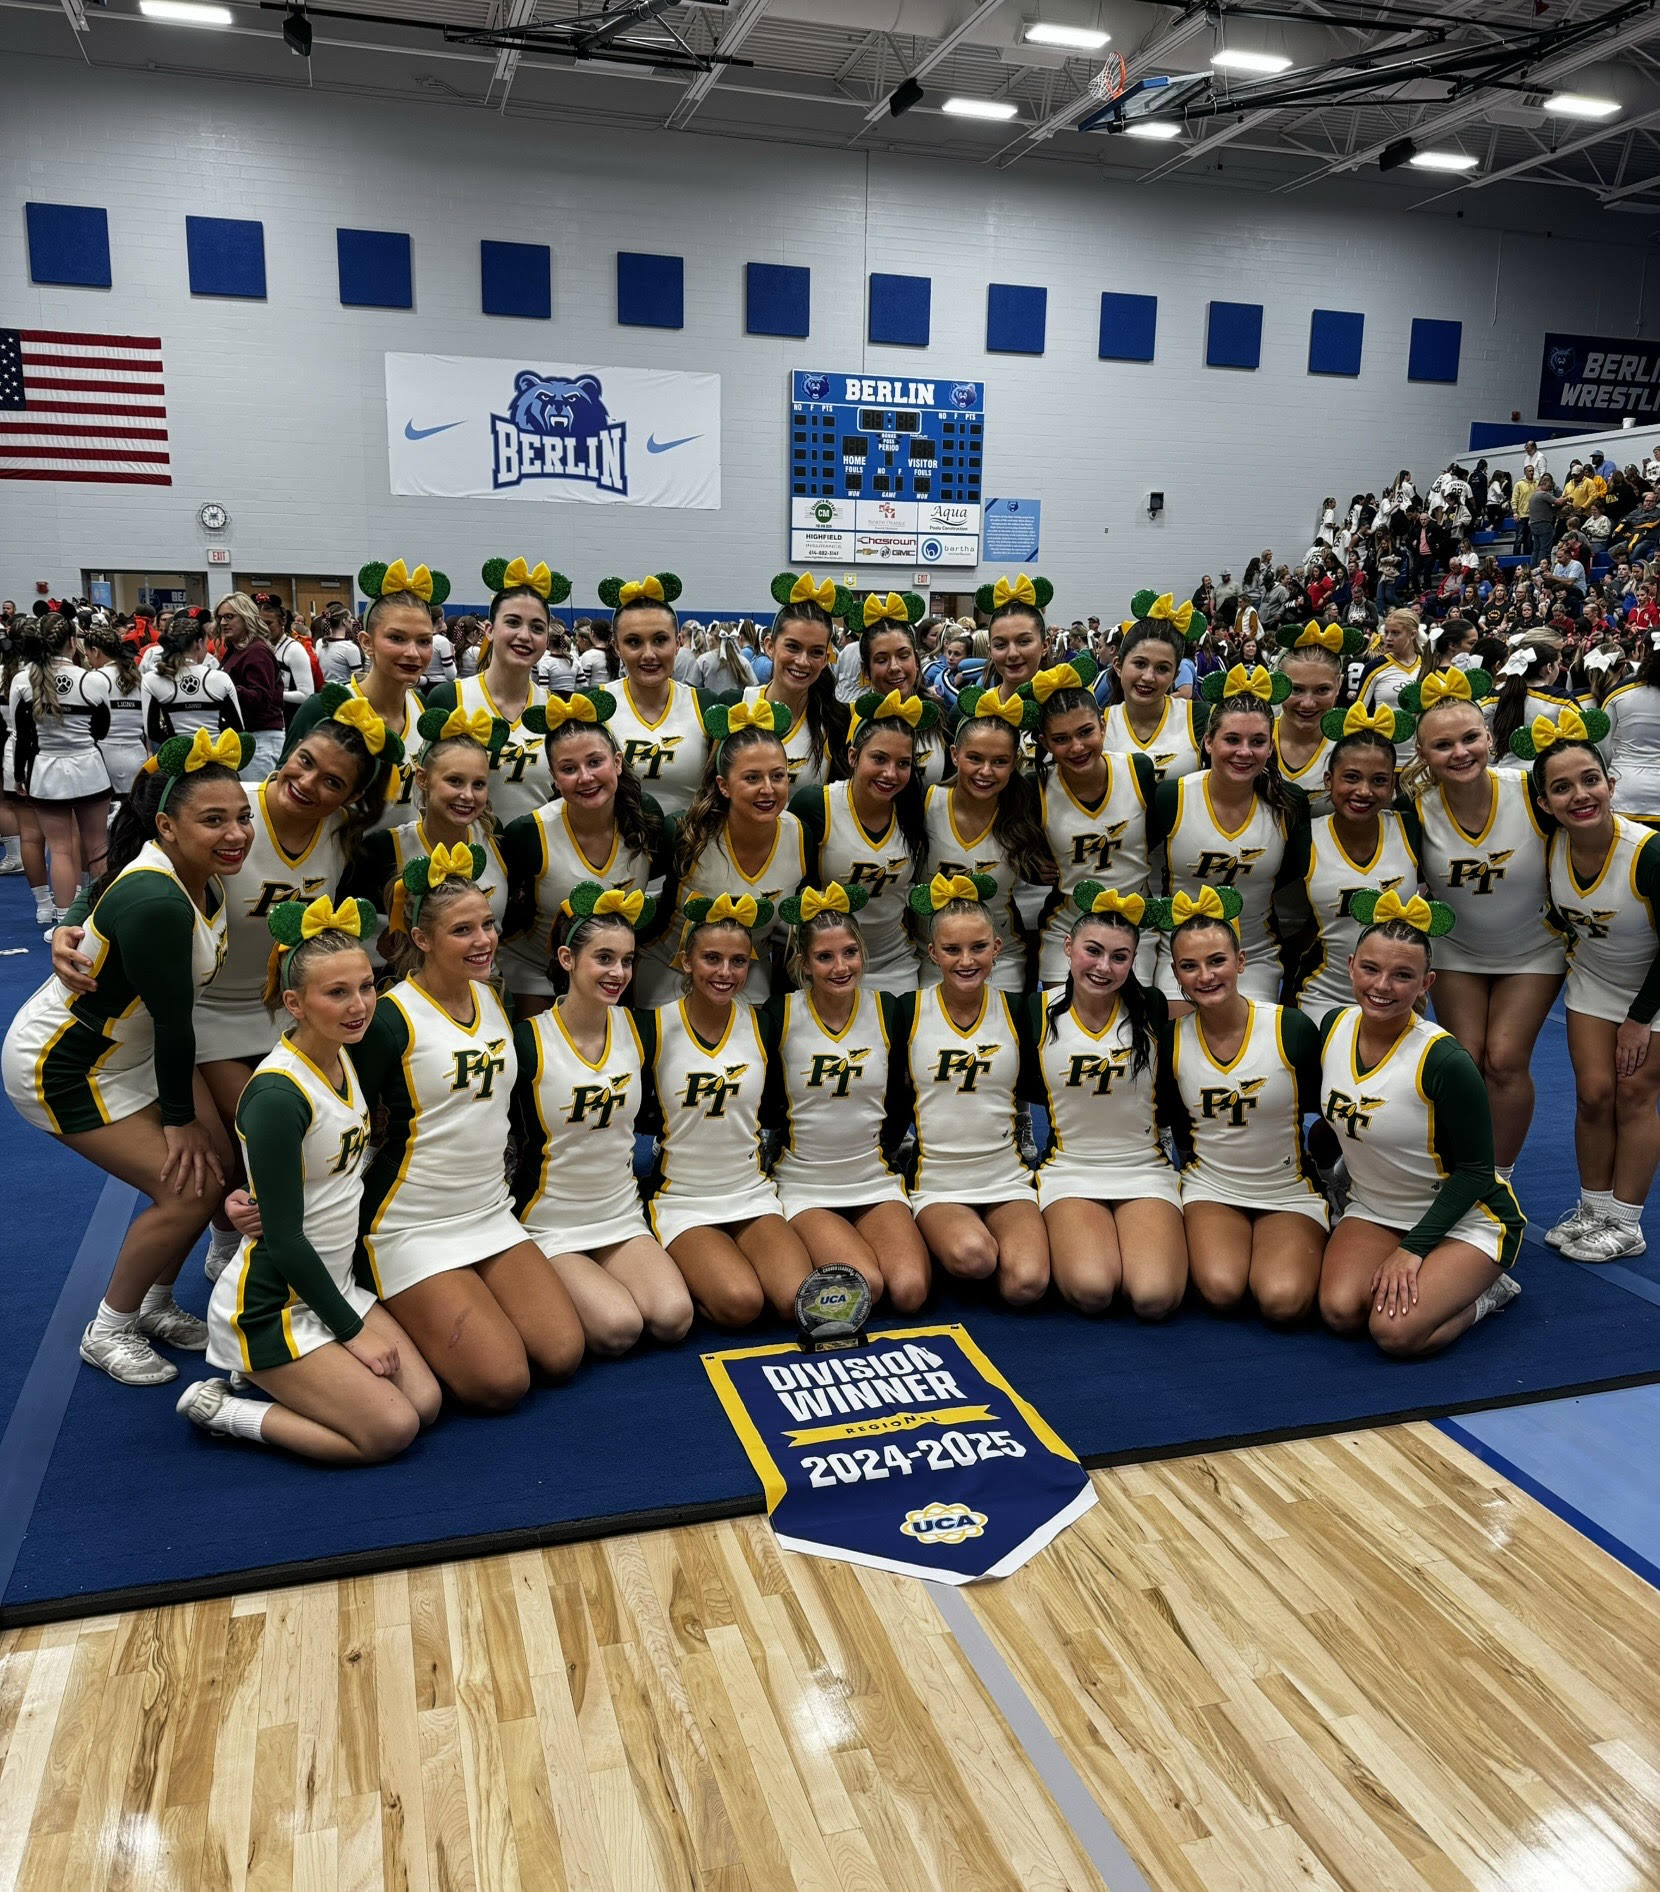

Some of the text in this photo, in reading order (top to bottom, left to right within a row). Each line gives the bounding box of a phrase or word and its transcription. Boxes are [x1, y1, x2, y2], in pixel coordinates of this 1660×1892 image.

[1582, 352, 1660, 383] BERLI
[845, 378, 934, 405] BERLIN
[495, 419, 623, 490] BERLIN
[843, 456, 866, 465] HOME
[908, 459, 938, 468] VISITOR
[818, 509, 830, 518] CM
[930, 506, 968, 521] Aqua
[213, 552, 225, 560] EXIT
[857, 536, 916, 545] Chesrown
[918, 574, 928, 583] EXIT
[1070, 832, 1124, 874] PT
[1190, 849, 1257, 887] PT
[849, 860, 902, 898] PT
[1446, 857, 1509, 896] PT
[449, 1048, 505, 1101] PT
[804, 1052, 864, 1099] PT
[931, 1048, 993, 1095] PT
[1064, 1053, 1127, 1097] PT
[565, 1083, 626, 1132] PT
[680, 1070, 742, 1120] PT
[1199, 1086, 1257, 1128] PT
[1324, 1088, 1375, 1142] PT
[820, 1294, 846, 1305] UCA
[761, 1344, 944, 1391] DIVISION
[776, 1370, 968, 1422] WINNER
[846, 1414, 940, 1434] REGIONL
[801, 1431, 1027, 1488] 2024-2025
[912, 1515, 976, 1533] UCA
